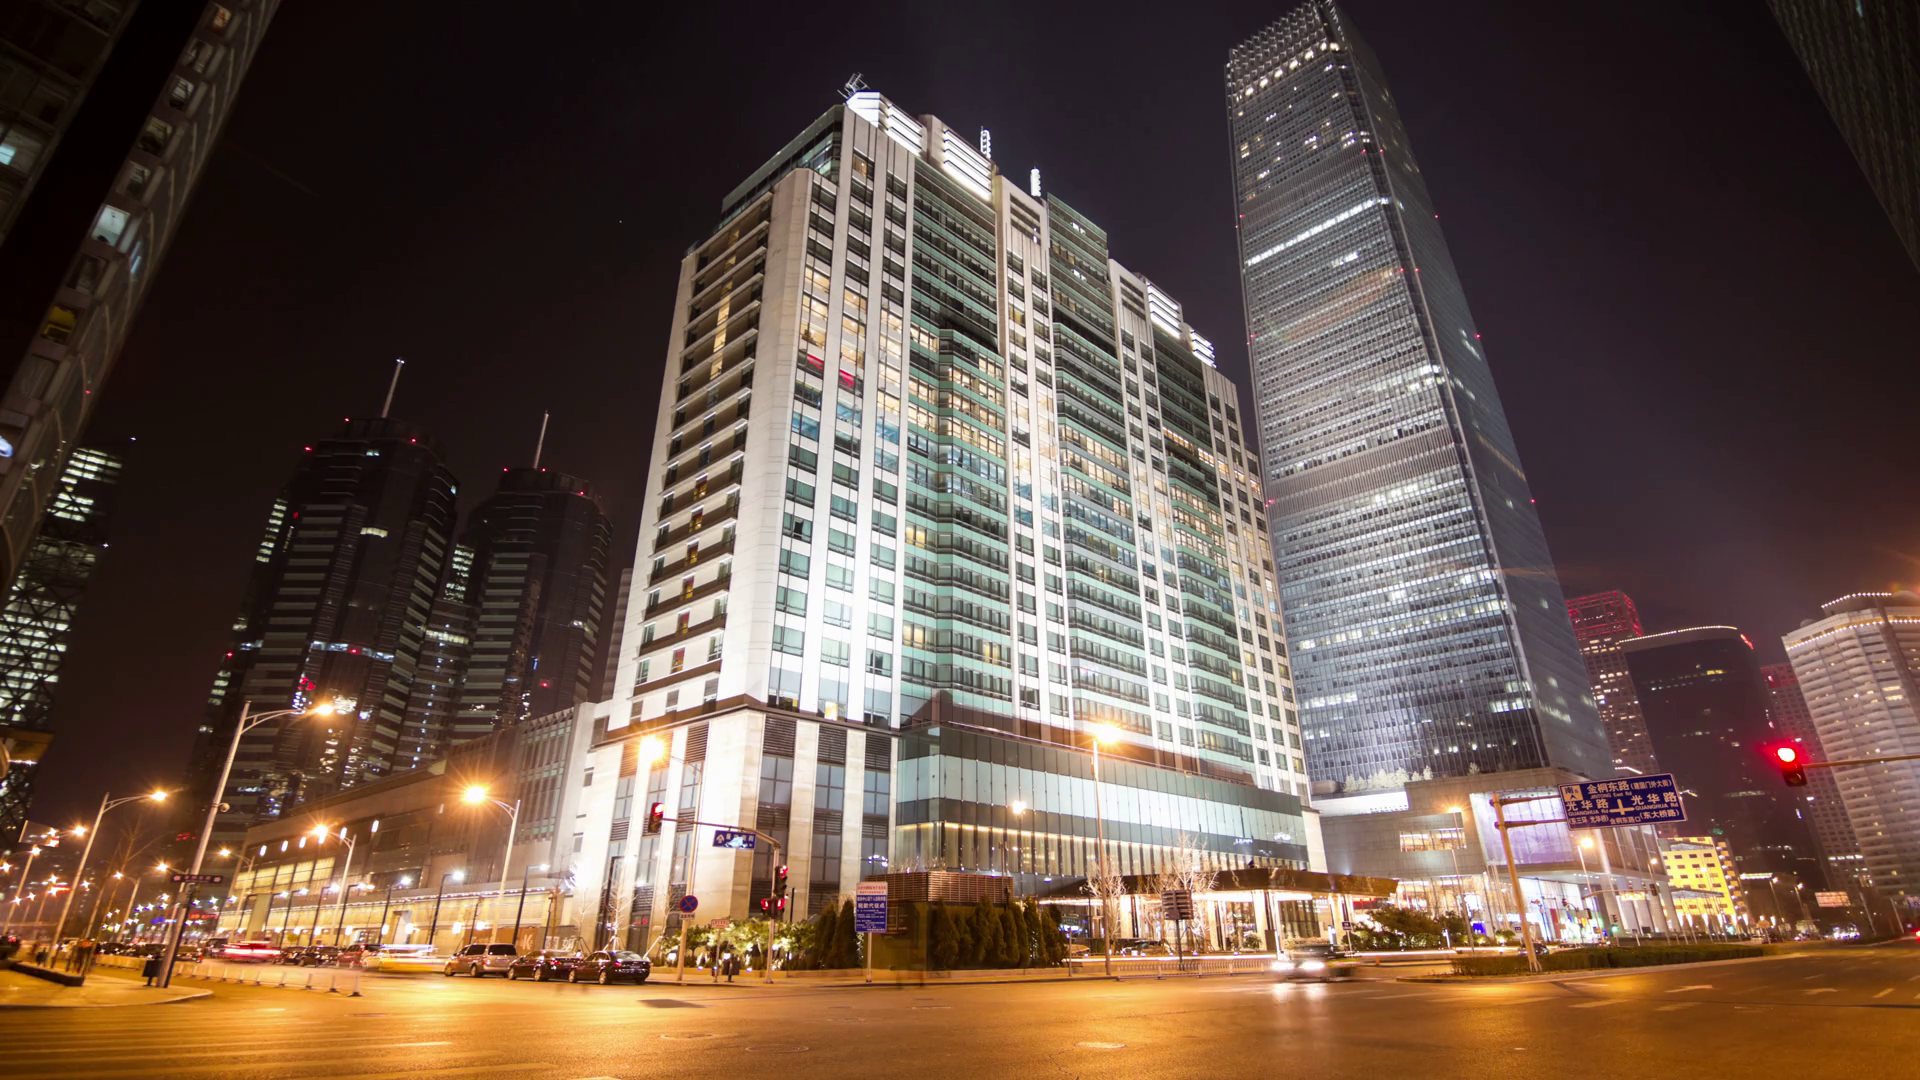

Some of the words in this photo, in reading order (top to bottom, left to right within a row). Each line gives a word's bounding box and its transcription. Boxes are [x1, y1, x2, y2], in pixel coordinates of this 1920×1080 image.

[1587, 781, 1629, 794] 金桐东路
[1566, 799, 1609, 811] 光华路
[1631, 792, 1677, 806] 光华路
[1635, 803, 1668, 811] GUANGHUA
